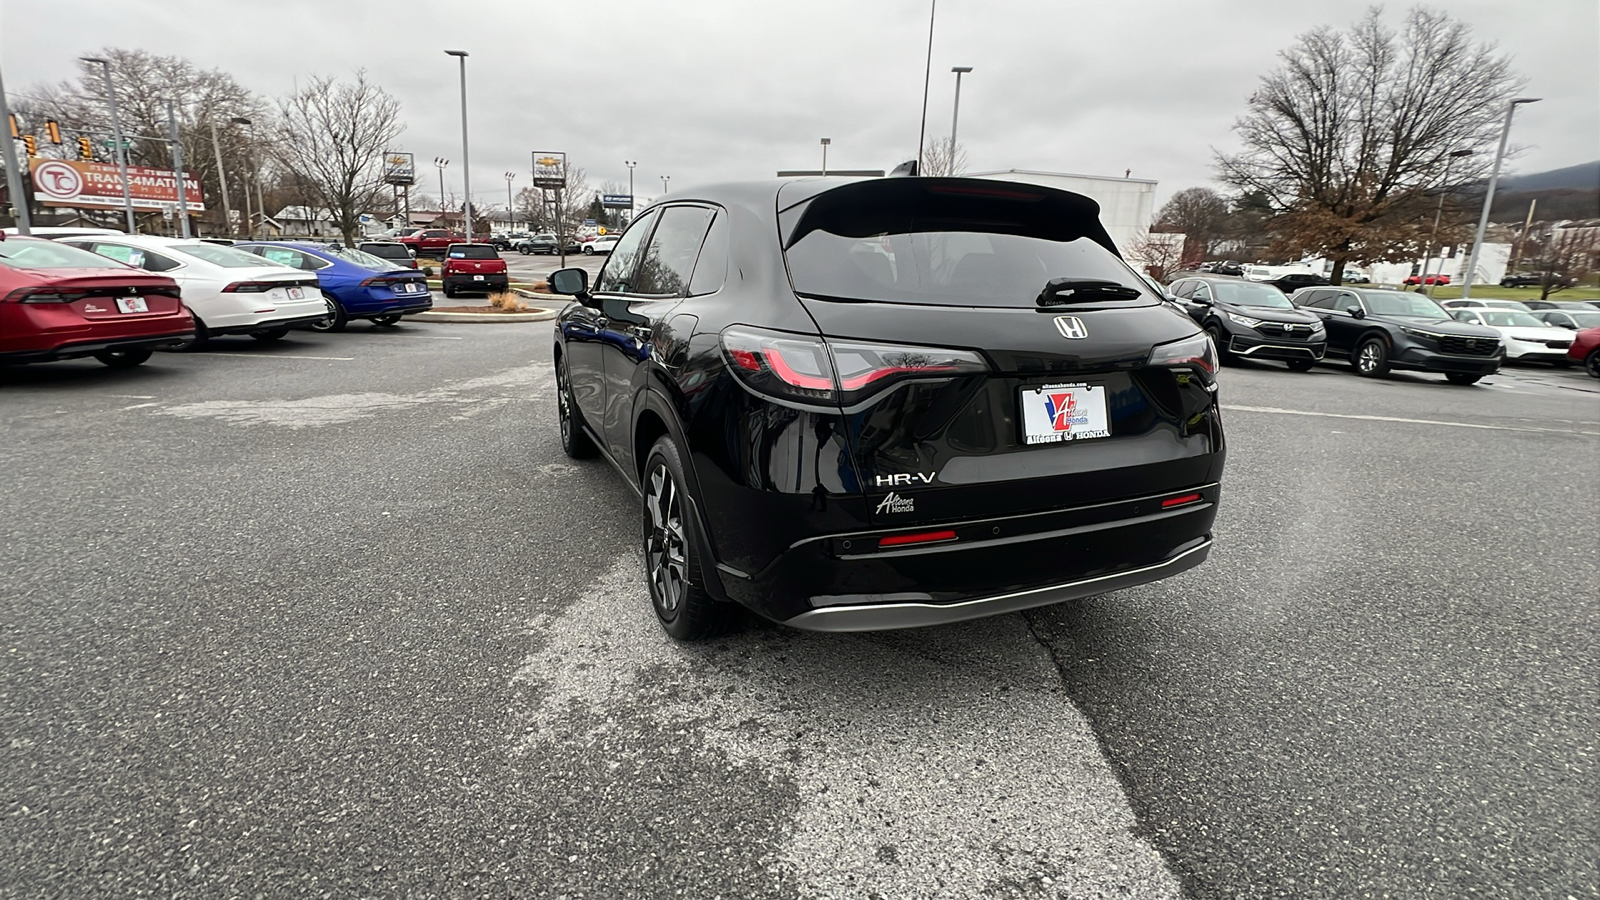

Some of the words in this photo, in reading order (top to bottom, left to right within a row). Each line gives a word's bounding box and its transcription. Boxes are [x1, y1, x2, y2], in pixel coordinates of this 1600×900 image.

[128, 184, 200, 196] CHURH
[1027, 432, 1062, 445] Altoona
[1076, 429, 1111, 440] HONDA
[876, 471, 936, 487] HR-V
[891, 505, 915, 513] Honda
